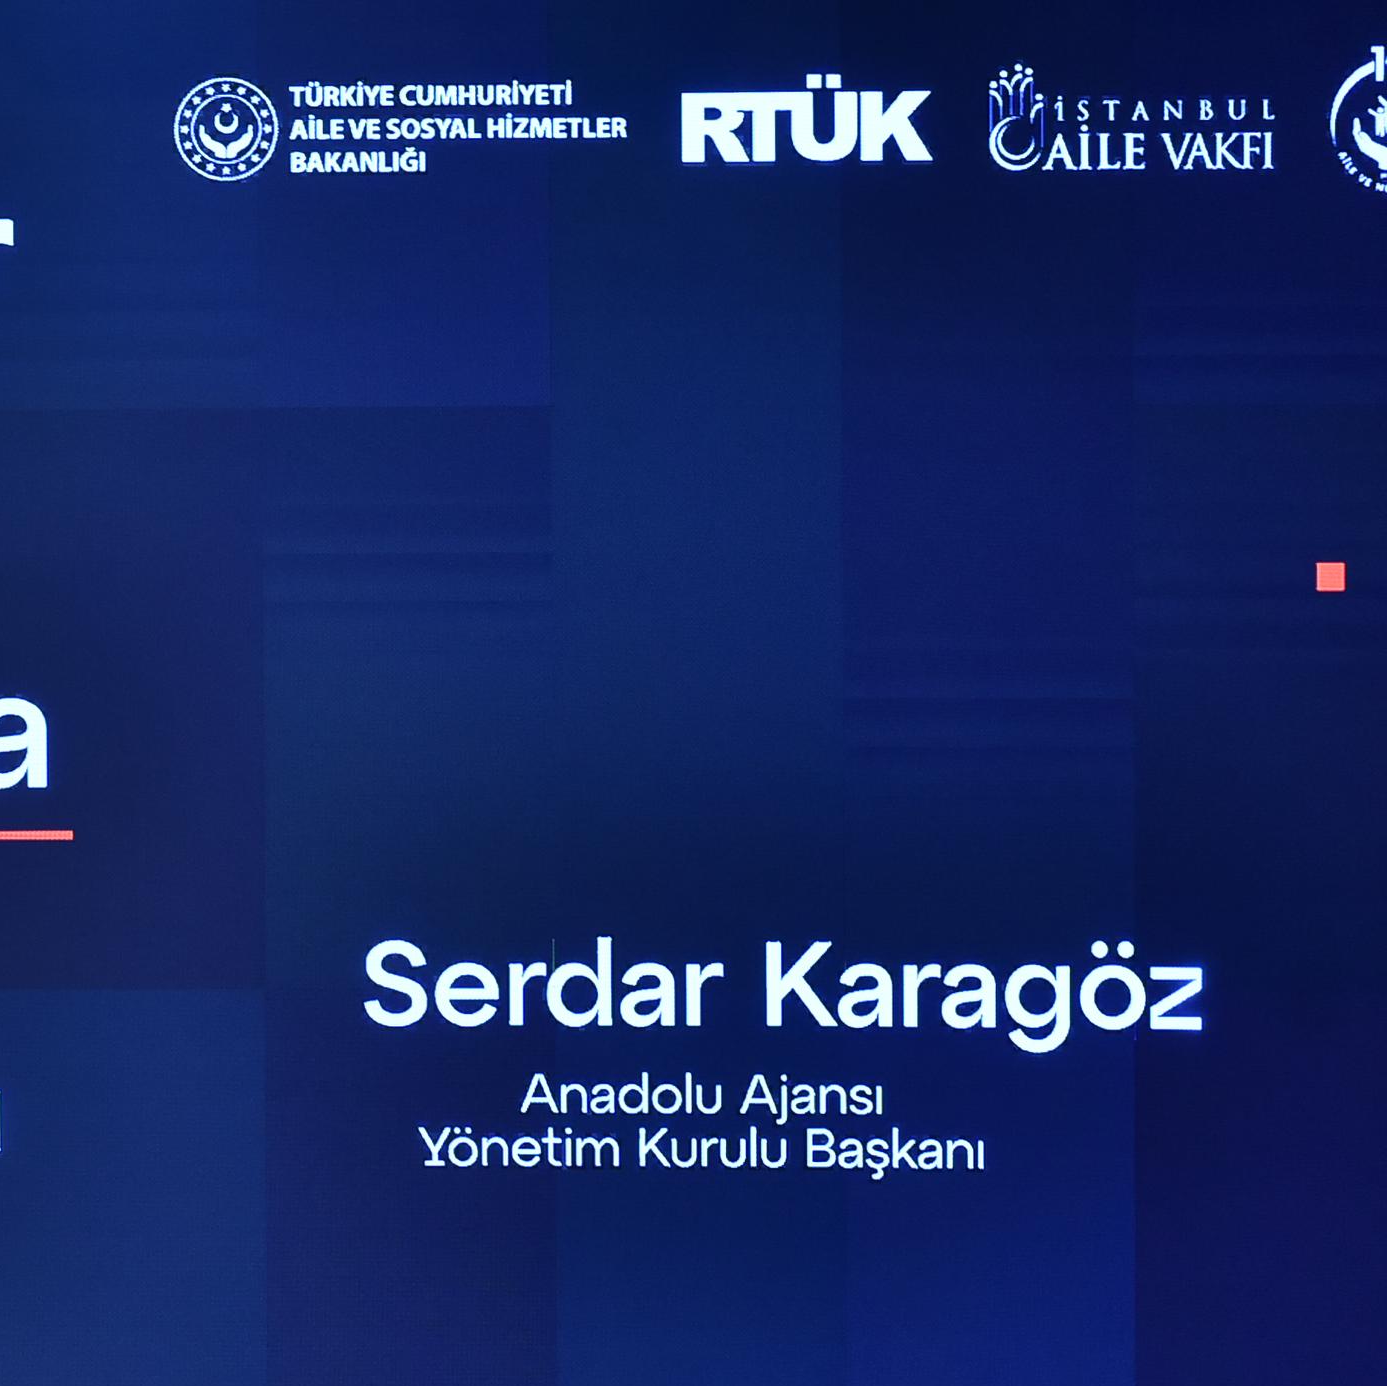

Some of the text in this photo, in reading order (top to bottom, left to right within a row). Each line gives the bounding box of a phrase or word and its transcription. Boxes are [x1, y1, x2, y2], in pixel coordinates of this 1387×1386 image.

[1371, 45, 1387, 82] 1
[289, 80, 572, 107] TÜRKİYE CUMHURİYETİ
[1055, 96, 1275, 121] İSTANBUL
[289, 113, 627, 140] AİLE VE SOSYAL HİZMETLER
[682, 74, 933, 162] RTÜK
[291, 147, 425, 173] BAKANLIĞI
[1042, 125, 1273, 170] AİLE VAKFI
[364, 937, 1202, 1053] Serdar Karagöz
[521, 1072, 882, 1125] Anadolu Ajansı
[418, 1127, 984, 1179] Yönetim Kurulu Başkanı
